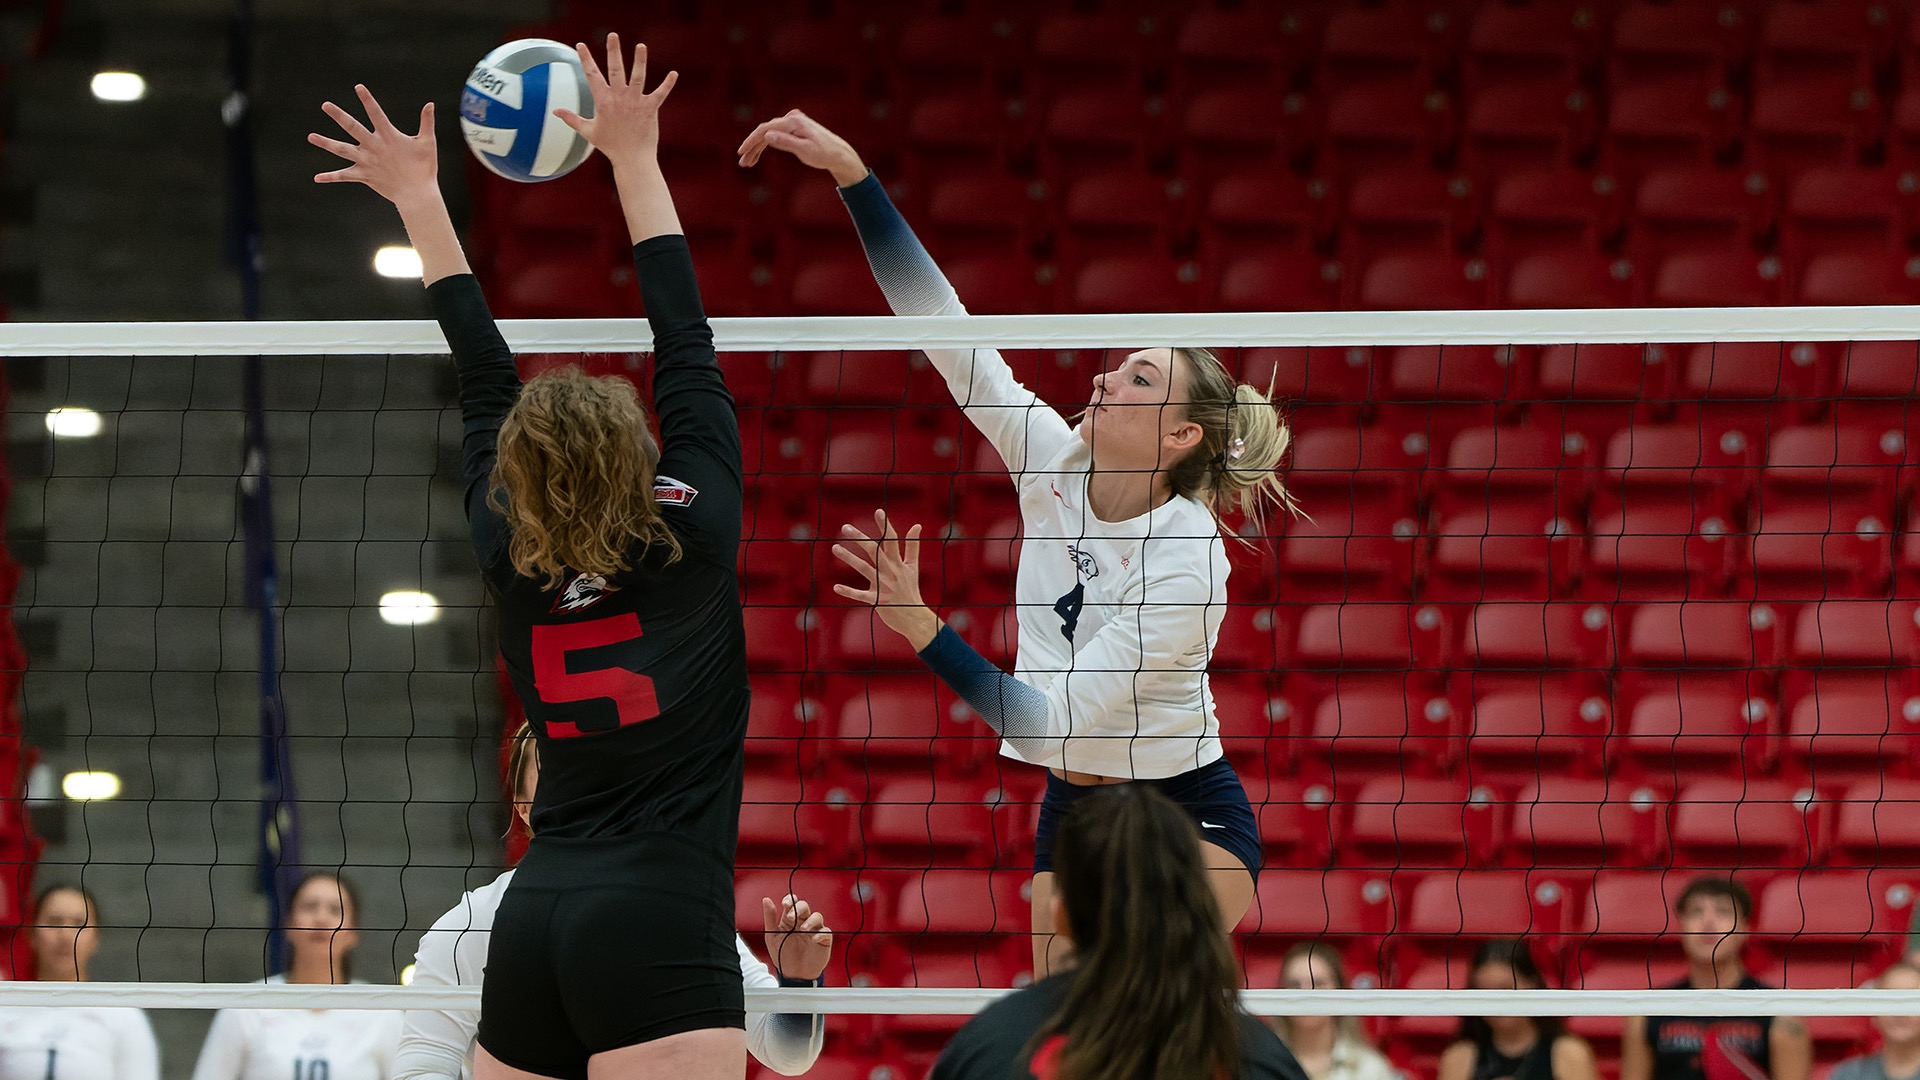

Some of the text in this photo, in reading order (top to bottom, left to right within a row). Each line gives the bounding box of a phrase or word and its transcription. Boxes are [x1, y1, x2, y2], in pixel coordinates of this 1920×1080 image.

[1053, 582, 1085, 643] 4
[531, 612, 661, 739] 5
[293, 1057, 329, 1080] 10
